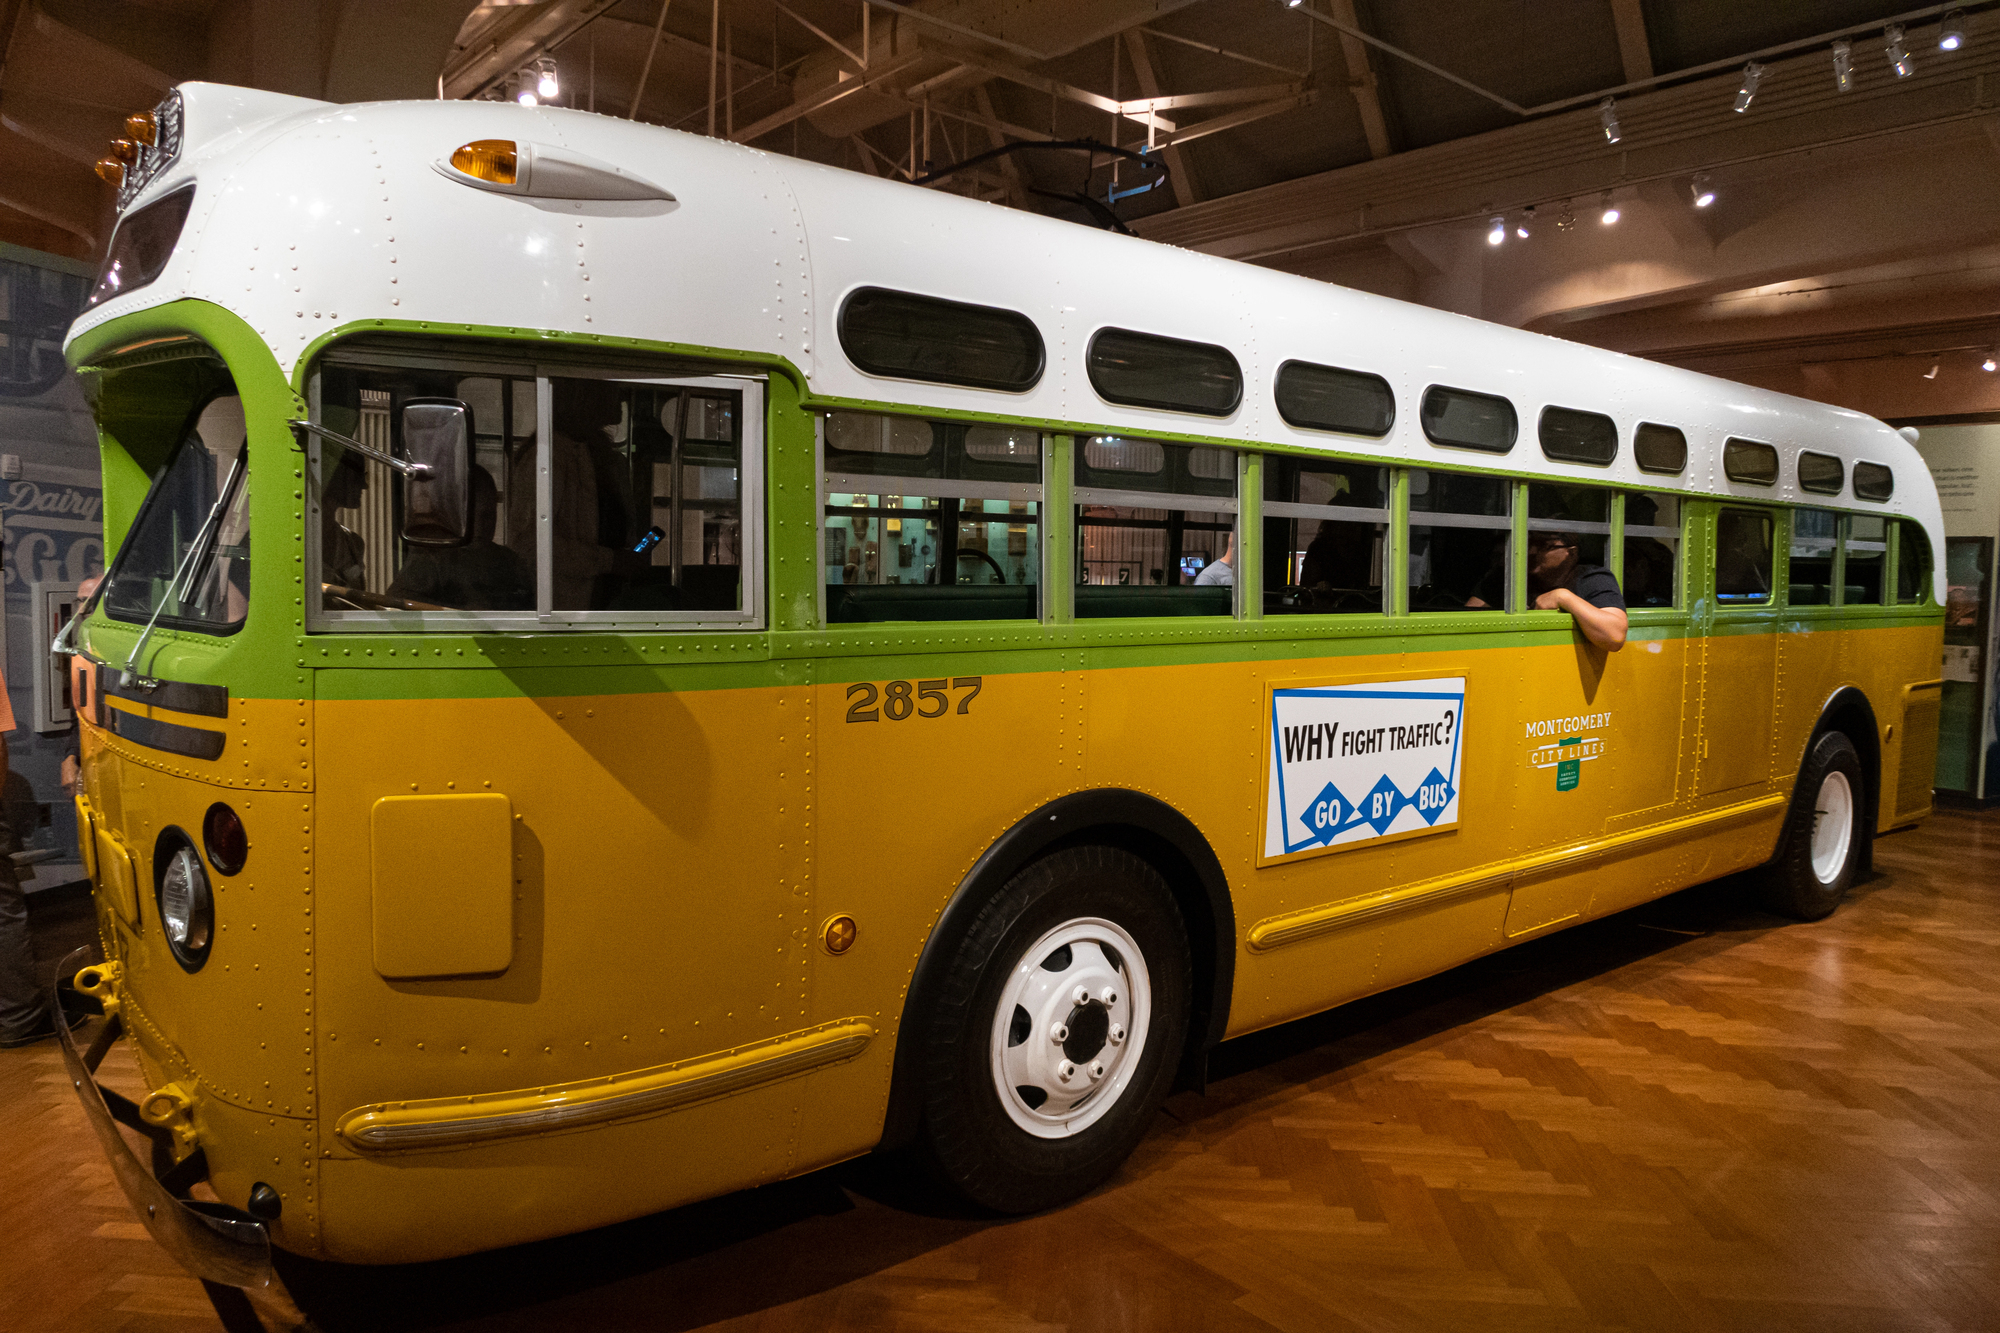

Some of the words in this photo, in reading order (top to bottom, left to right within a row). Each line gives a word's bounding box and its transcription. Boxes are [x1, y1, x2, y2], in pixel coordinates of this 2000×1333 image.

[1, 481, 103, 520] Dairy
[1120, 571, 1129, 582] 7
[846, 676, 982, 723] 2857
[1284, 722, 1339, 763] WHY
[1342, 728, 1385, 757] FIGHT
[1389, 710, 1454, 751] TRAFFIC?
[1525, 712, 1612, 738] MONTGOMERY
[1531, 749, 1563, 764] CITY
[1569, 742, 1605, 758] LINES
[1315, 799, 1341, 829] GO
[1372, 791, 1394, 819] BY
[1419, 782, 1448, 811] BUS
